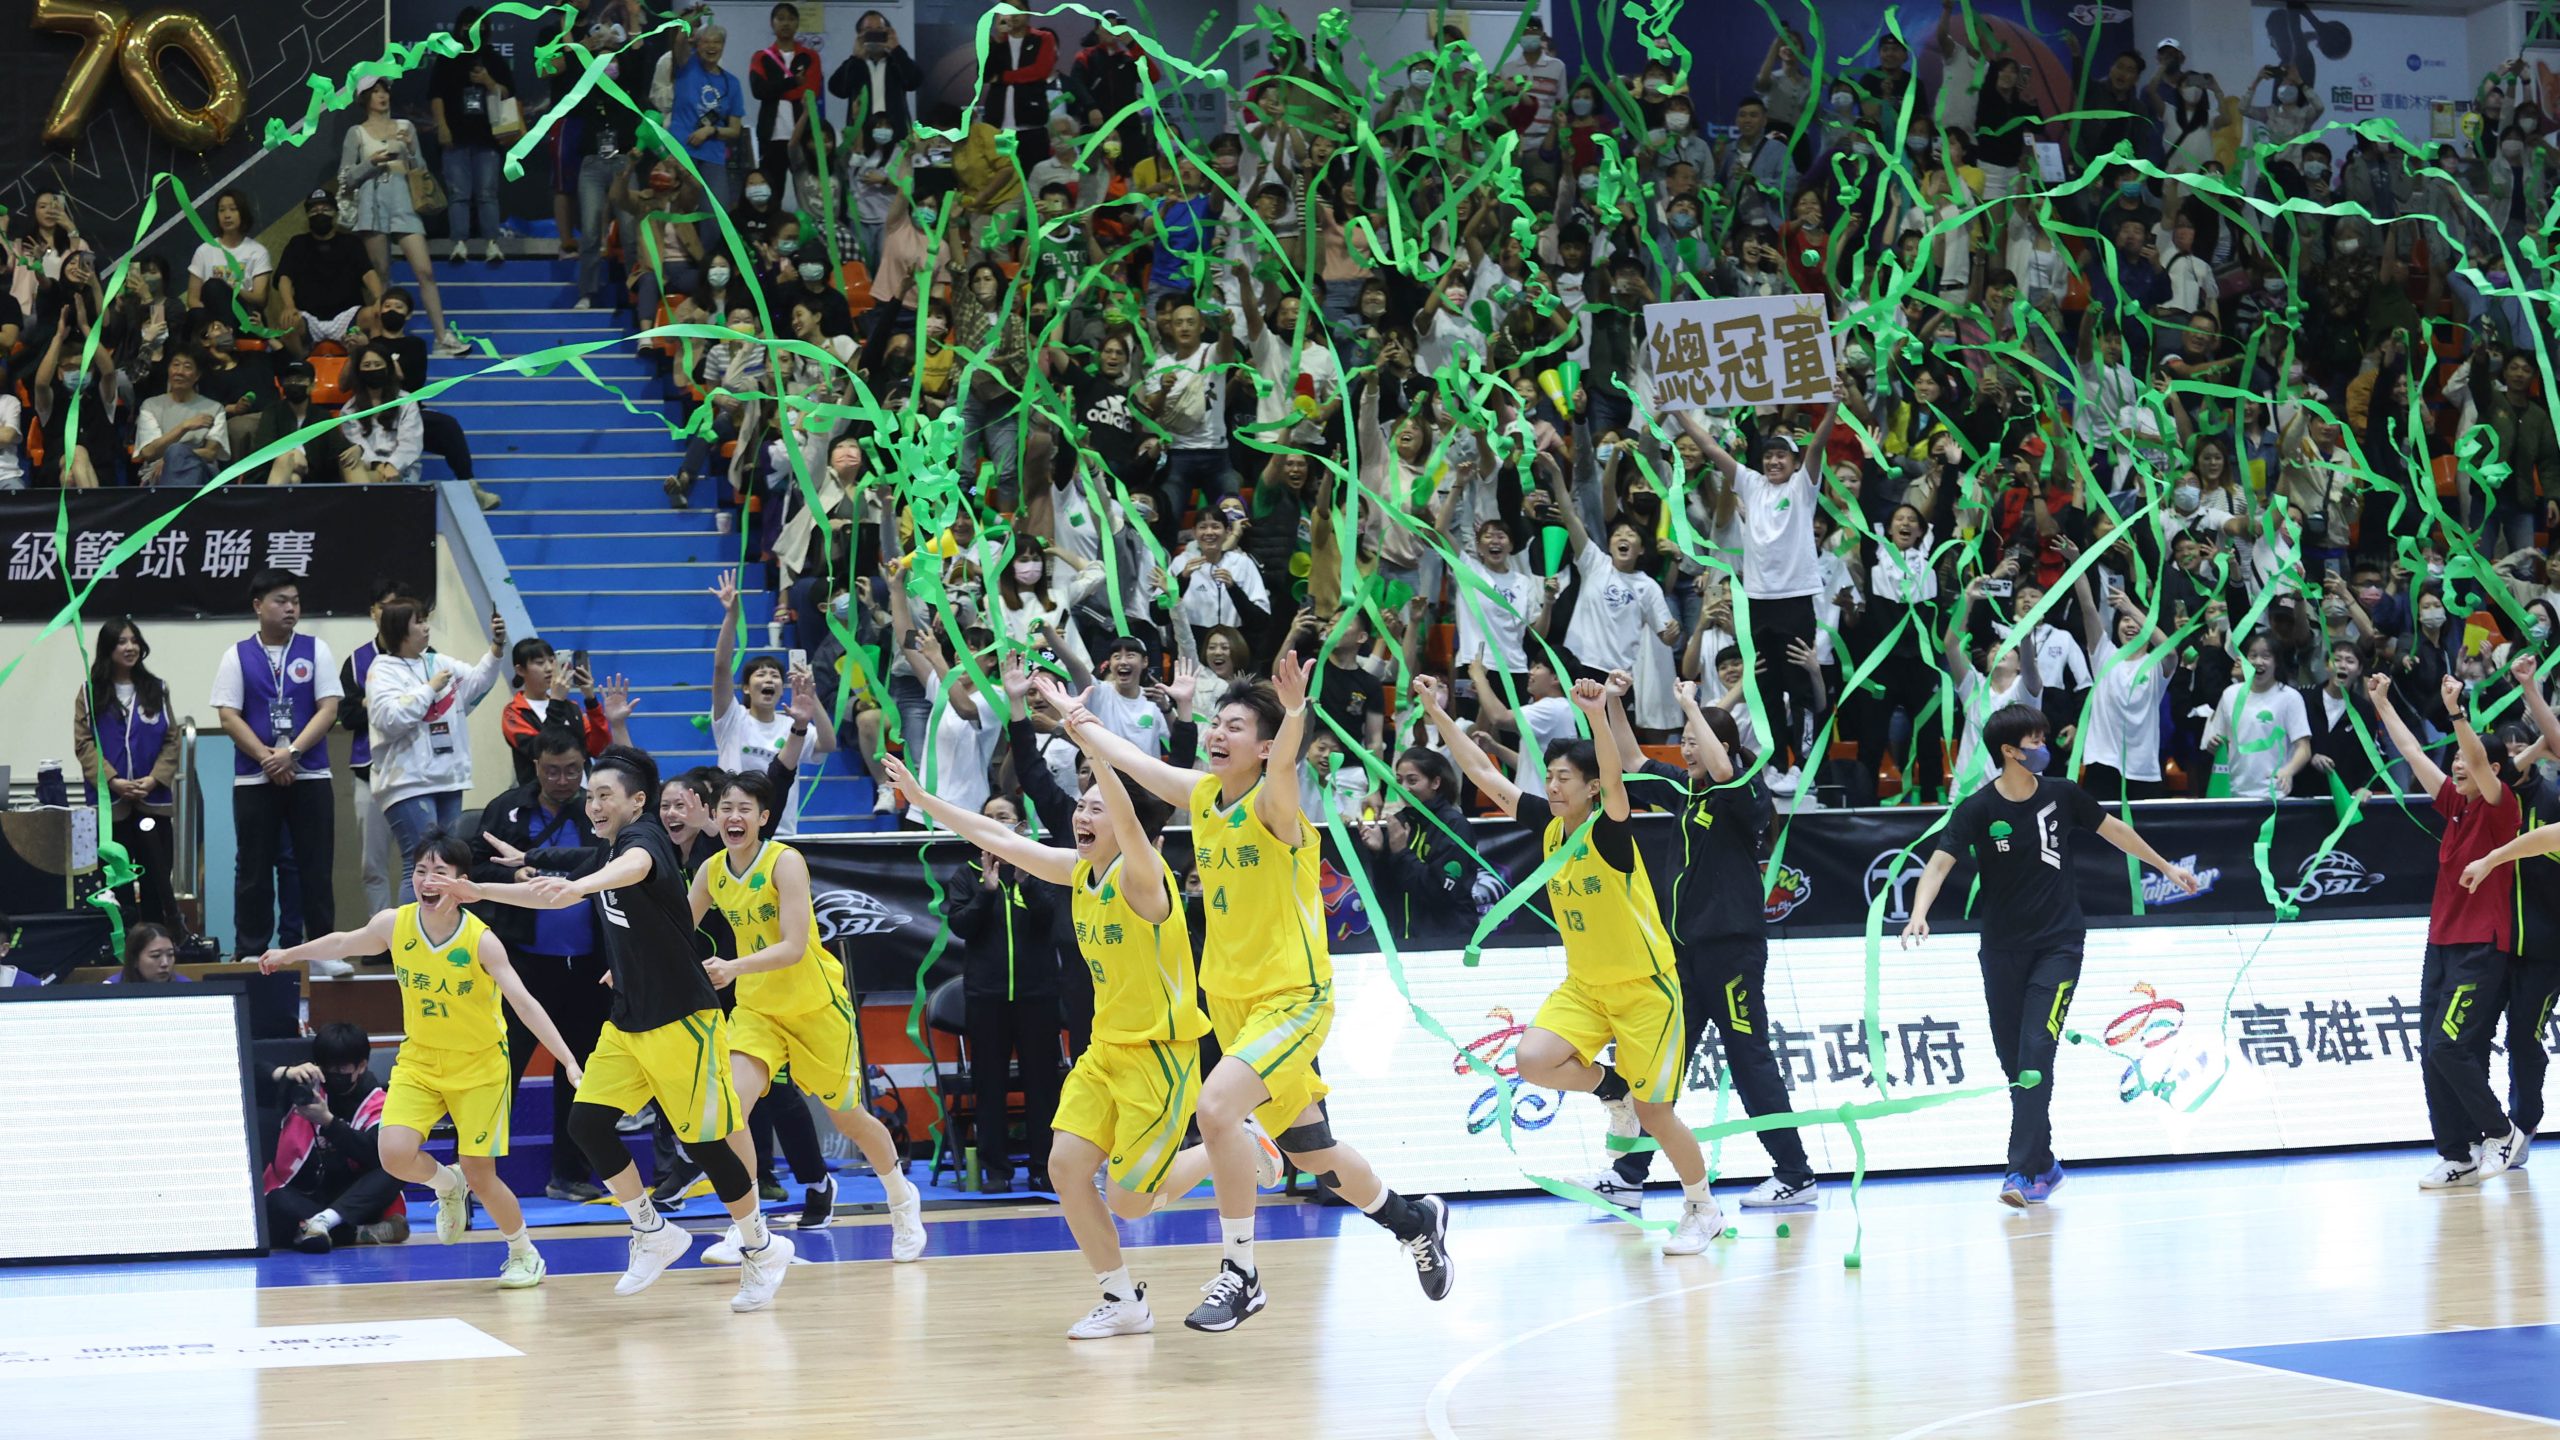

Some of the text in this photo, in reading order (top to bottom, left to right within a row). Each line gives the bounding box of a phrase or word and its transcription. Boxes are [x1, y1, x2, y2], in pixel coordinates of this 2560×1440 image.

[30, 0, 246, 150] 70
[1651, 313, 1834, 406] 總冠軍
[8, 529, 317, 581] 級籃球聯賽
[1996, 839, 2012, 853] 15
[1442, 877, 1457, 892] 17
[2279, 867, 2372, 903] SBL
[1211, 886, 1229, 915] 4
[1562, 908, 1587, 934] 13
[421, 998, 449, 1018] 21
